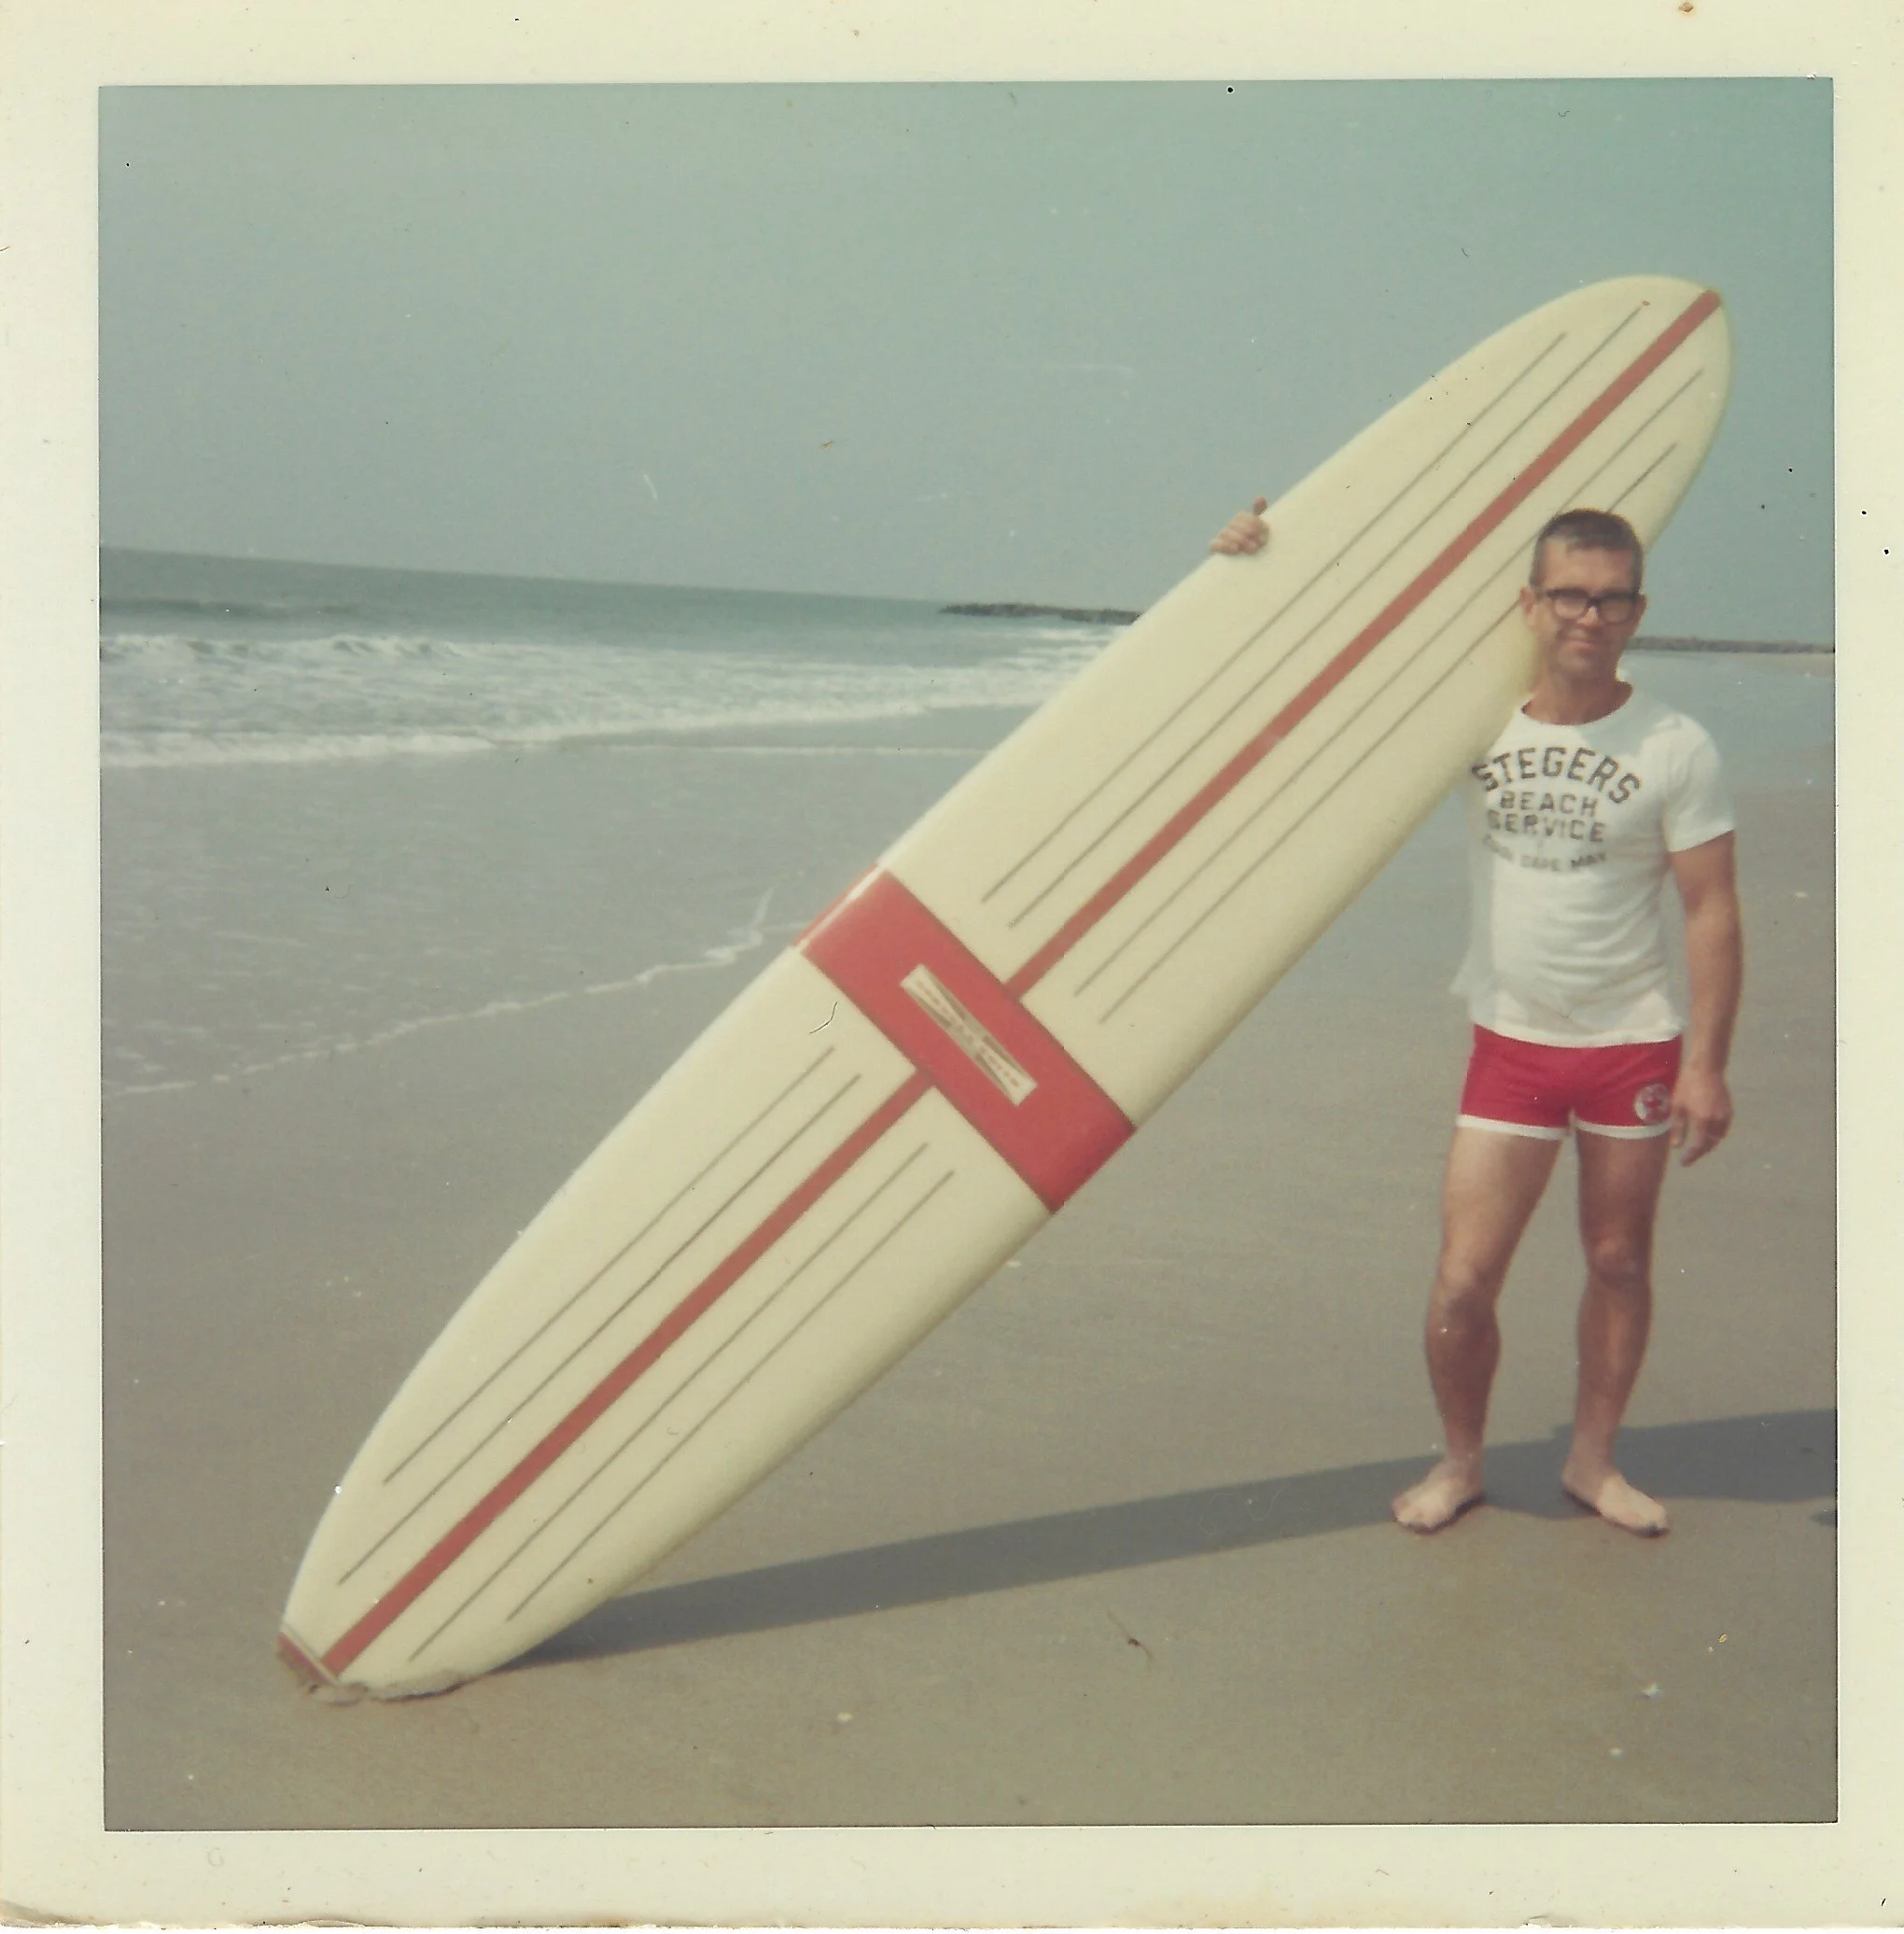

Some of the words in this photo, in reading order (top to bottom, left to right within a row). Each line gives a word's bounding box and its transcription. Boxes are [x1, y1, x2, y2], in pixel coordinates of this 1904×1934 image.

[1471, 746, 1642, 805] STEGERS
[1499, 790, 1599, 818] BEACH
[1487, 808, 1606, 842] SERVICE
